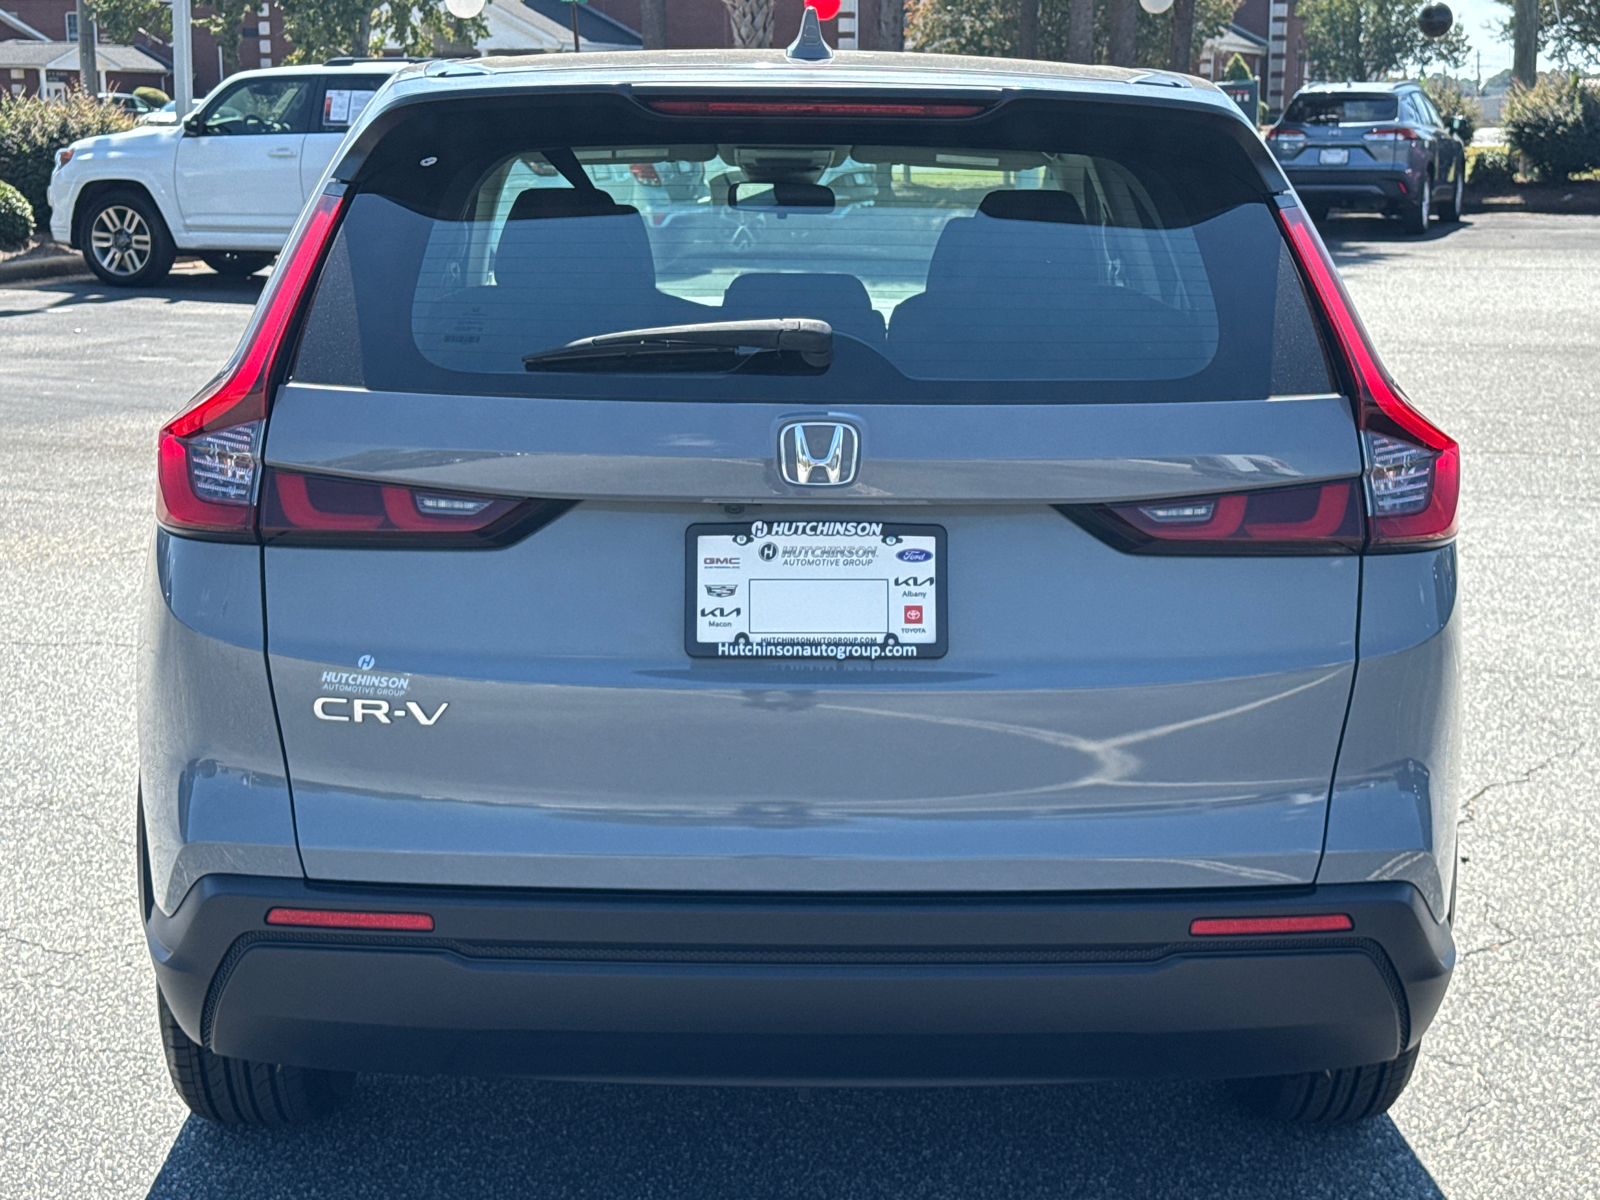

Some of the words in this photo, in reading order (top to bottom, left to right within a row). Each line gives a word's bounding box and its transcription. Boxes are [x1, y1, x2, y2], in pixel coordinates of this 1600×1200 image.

[771, 522, 883, 536] HUTCHINSON
[781, 545, 878, 558] HUTCHINSON
[704, 557, 740, 565] GMC
[783, 558, 840, 566] AUTOMOTIVE
[842, 558, 873, 566] GROUP
[902, 590, 927, 598] Albany
[708, 620, 732, 628] Macon
[760, 636, 877, 644] HUTCHINSONAUTOGROUP.COM
[717, 642, 917, 659] Hutchinsonautogroup.com
[321, 671, 410, 689] HUTCHINSON
[322, 683, 375, 695] AUTOMOTIVE
[376, 688, 405, 696] GROUP
[313, 697, 449, 726] CR-V
